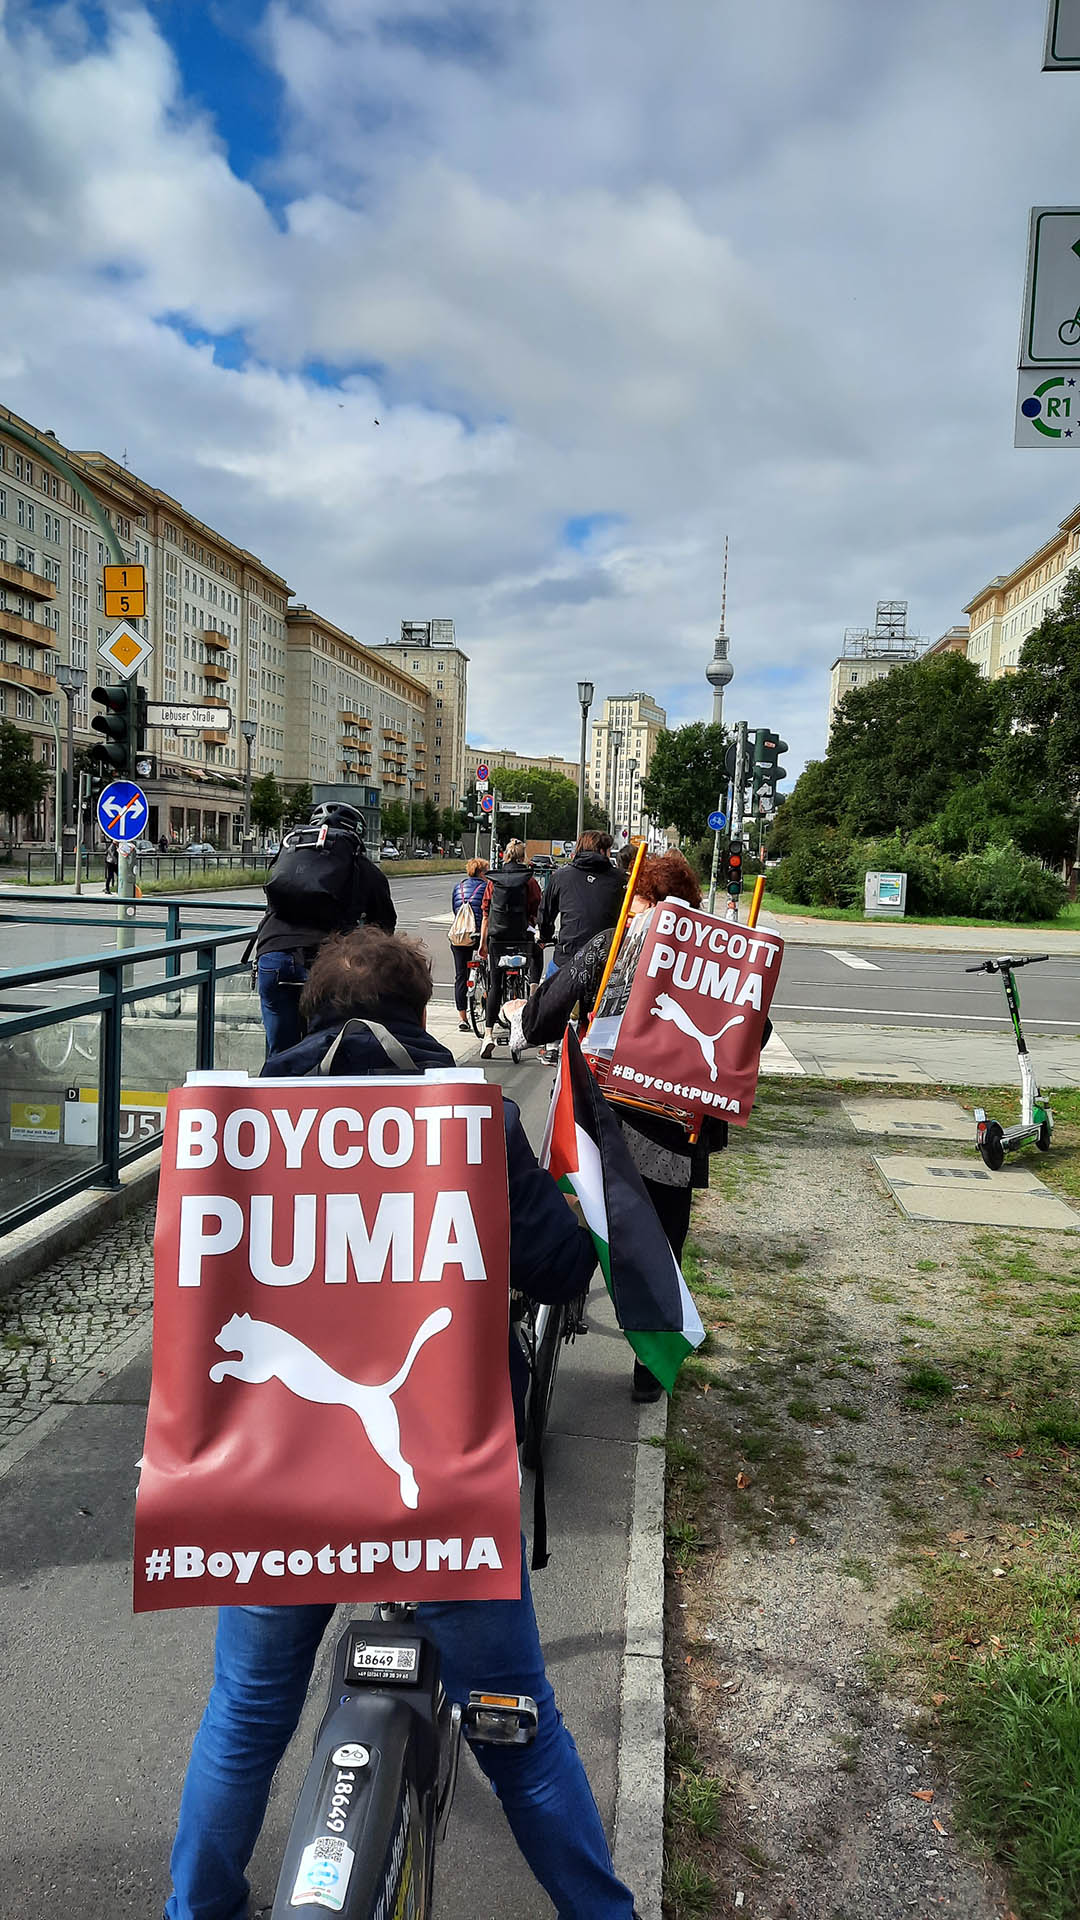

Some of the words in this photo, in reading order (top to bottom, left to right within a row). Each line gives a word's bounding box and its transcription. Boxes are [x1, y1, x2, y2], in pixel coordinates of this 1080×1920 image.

[1046, 397, 1072, 418] R1
[121, 570, 127, 587] 1
[120, 596, 130, 613] 5
[161, 708, 190, 721] Lebuser
[192, 710, 216, 723] Straße
[655, 909, 780, 968] BOYCOTT
[646, 942, 764, 1012] PUMA
[68, 1089, 77, 1099] D
[611, 1063, 741, 1115] #BoycottPUMA
[175, 1104, 493, 1170] BOYCOTT
[177, 1190, 488, 1287] PUMA
[144, 1536, 503, 1585] #BoycottPUMA
[356, 1654, 394, 1667] 18649
[326, 1769, 356, 1832] 18649
